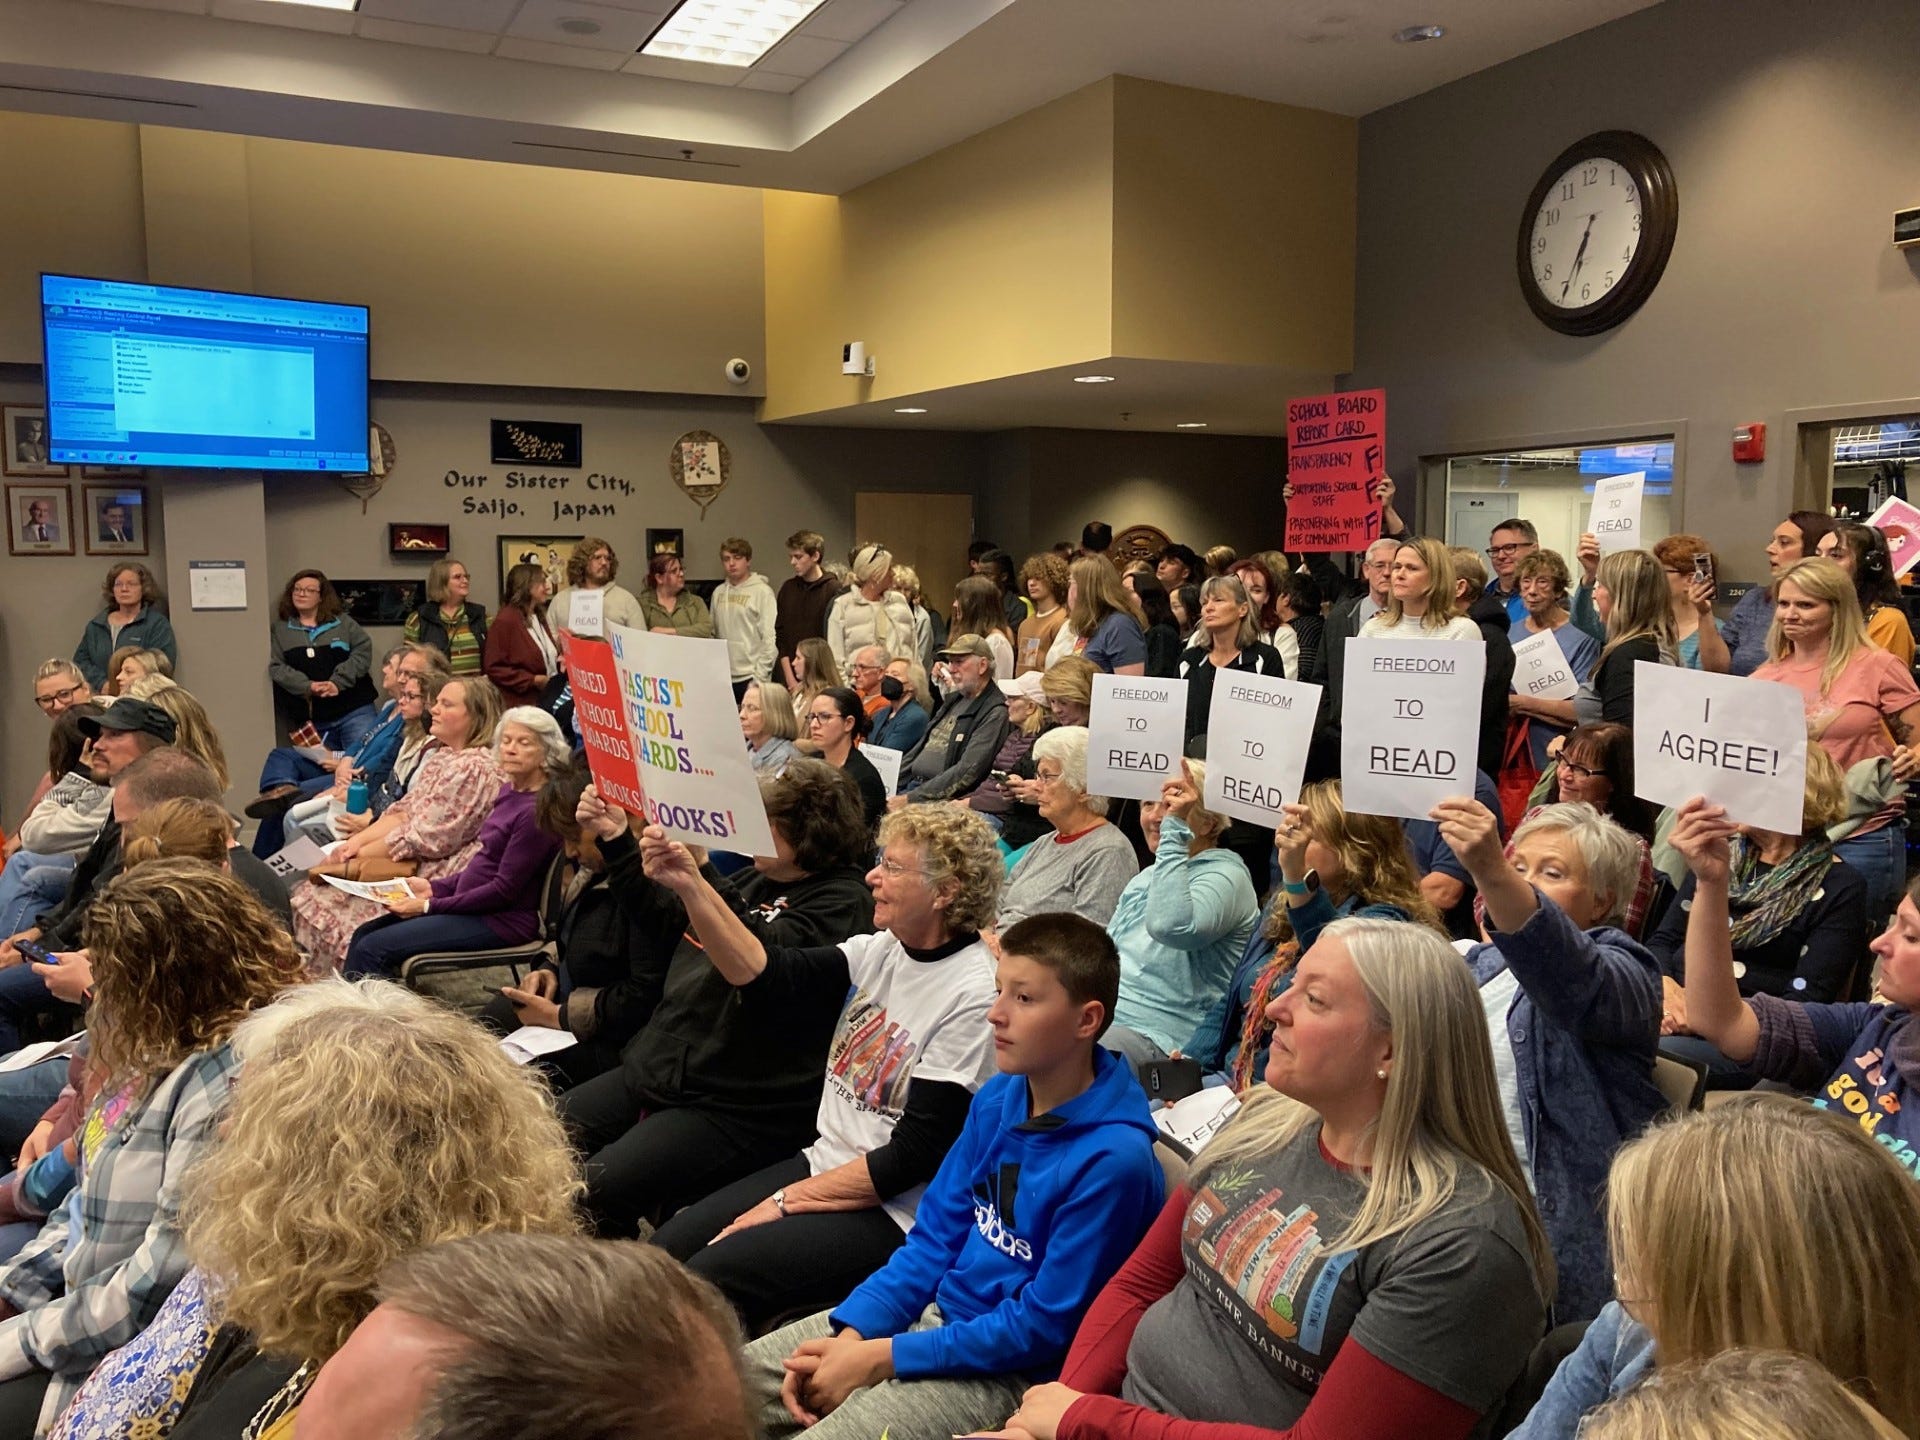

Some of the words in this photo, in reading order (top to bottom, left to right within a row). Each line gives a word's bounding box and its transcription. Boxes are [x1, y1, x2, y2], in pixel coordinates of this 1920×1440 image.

[1582, 167, 1599, 187] 12
[1609, 169, 1616, 186] 1
[1561, 182, 1575, 201] 11
[1625, 185, 1635, 203] 2
[1545, 208, 1560, 227] 10
[1632, 213, 1642, 232] 3
[1537, 237, 1547, 254] 9
[1622, 245, 1631, 263] 4
[1543, 264, 1552, 281] 8
[1604, 271, 1613, 289] 5
[1581, 283, 1590, 301] 6
[1289, 401, 1329, 423] SCHOOL
[1338, 397, 1377, 414] BOARD
[1297, 422, 1330, 443] REPORT
[1335, 420, 1365, 437] CARD
[1364, 445, 1379, 473] F
[444, 470, 488, 489] Our
[505, 471, 569, 490] Sister
[1364, 477, 1377, 504] F
[553, 500, 616, 521] Japan
[1343, 517, 1364, 530] WITH
[1364, 510, 1378, 540] F
[1597, 518, 1632, 531] READ
[1288, 533, 1303, 546] THE
[1305, 532, 1350, 546] COMMUNITY
[1373, 657, 1456, 673] FREEDOM
[1528, 659, 1542, 669] TO
[622, 669, 684, 708] FASCIST
[1528, 670, 1566, 693] READ
[1111, 688, 1169, 702] FREEDOM
[1230, 686, 1293, 709] FREEDOM
[1394, 699, 1424, 718] TO
[1704, 697, 1710, 724] I
[626, 699, 683, 740] SCHOOL
[1126, 717, 1147, 731] TO
[1242, 739, 1265, 758] TO
[1658, 730, 1779, 776] AGREE!
[1108, 749, 1170, 772] READ
[1369, 745, 1456, 777] READ
[1223, 776, 1283, 810] READ
[650, 799, 737, 838] BOOKS!
[1267, 1221, 1287, 1244] MICE
[1244, 1255, 1260, 1282] MEN
[1216, 1287, 1242, 1325] THE
[1247, 1323, 1325, 1385] BANNE
